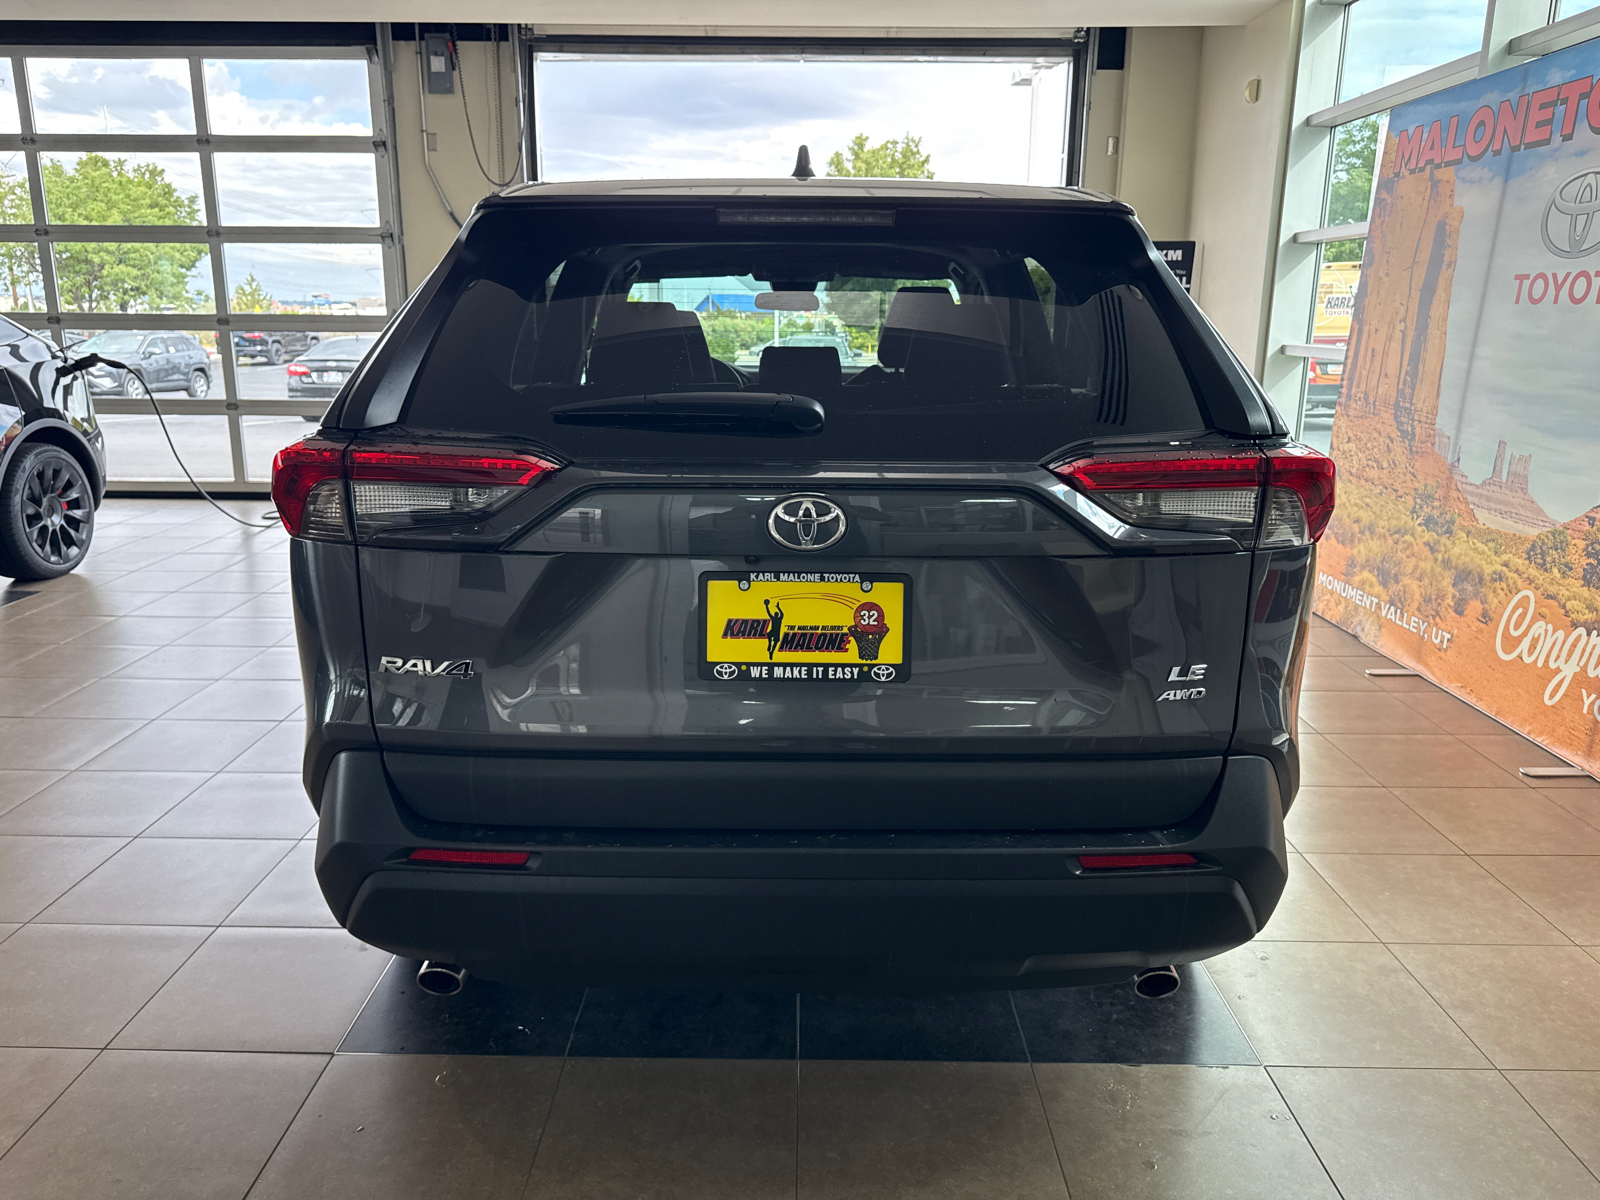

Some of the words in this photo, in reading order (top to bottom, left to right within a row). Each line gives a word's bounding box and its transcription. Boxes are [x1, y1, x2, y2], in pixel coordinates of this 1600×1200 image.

[750, 572, 777, 582] KARL
[780, 573, 821, 583] MALONE
[823, 574, 861, 583] TOYOTA
[860, 610, 879, 626] 32
[1318, 571, 1379, 613] MONUMENT
[1380, 601, 1428, 642] VALLEY,
[1431, 626, 1451, 649] UT
[721, 618, 772, 640] KARL
[778, 632, 852, 653] MALONE
[379, 656, 474, 680] RAV4
[750, 666, 768, 679] WE
[773, 666, 808, 679] MAKE
[812, 667, 823, 679] IT
[829, 667, 860, 680] EASY
[1167, 663, 1208, 682] LE
[1155, 687, 1206, 702] AWD
